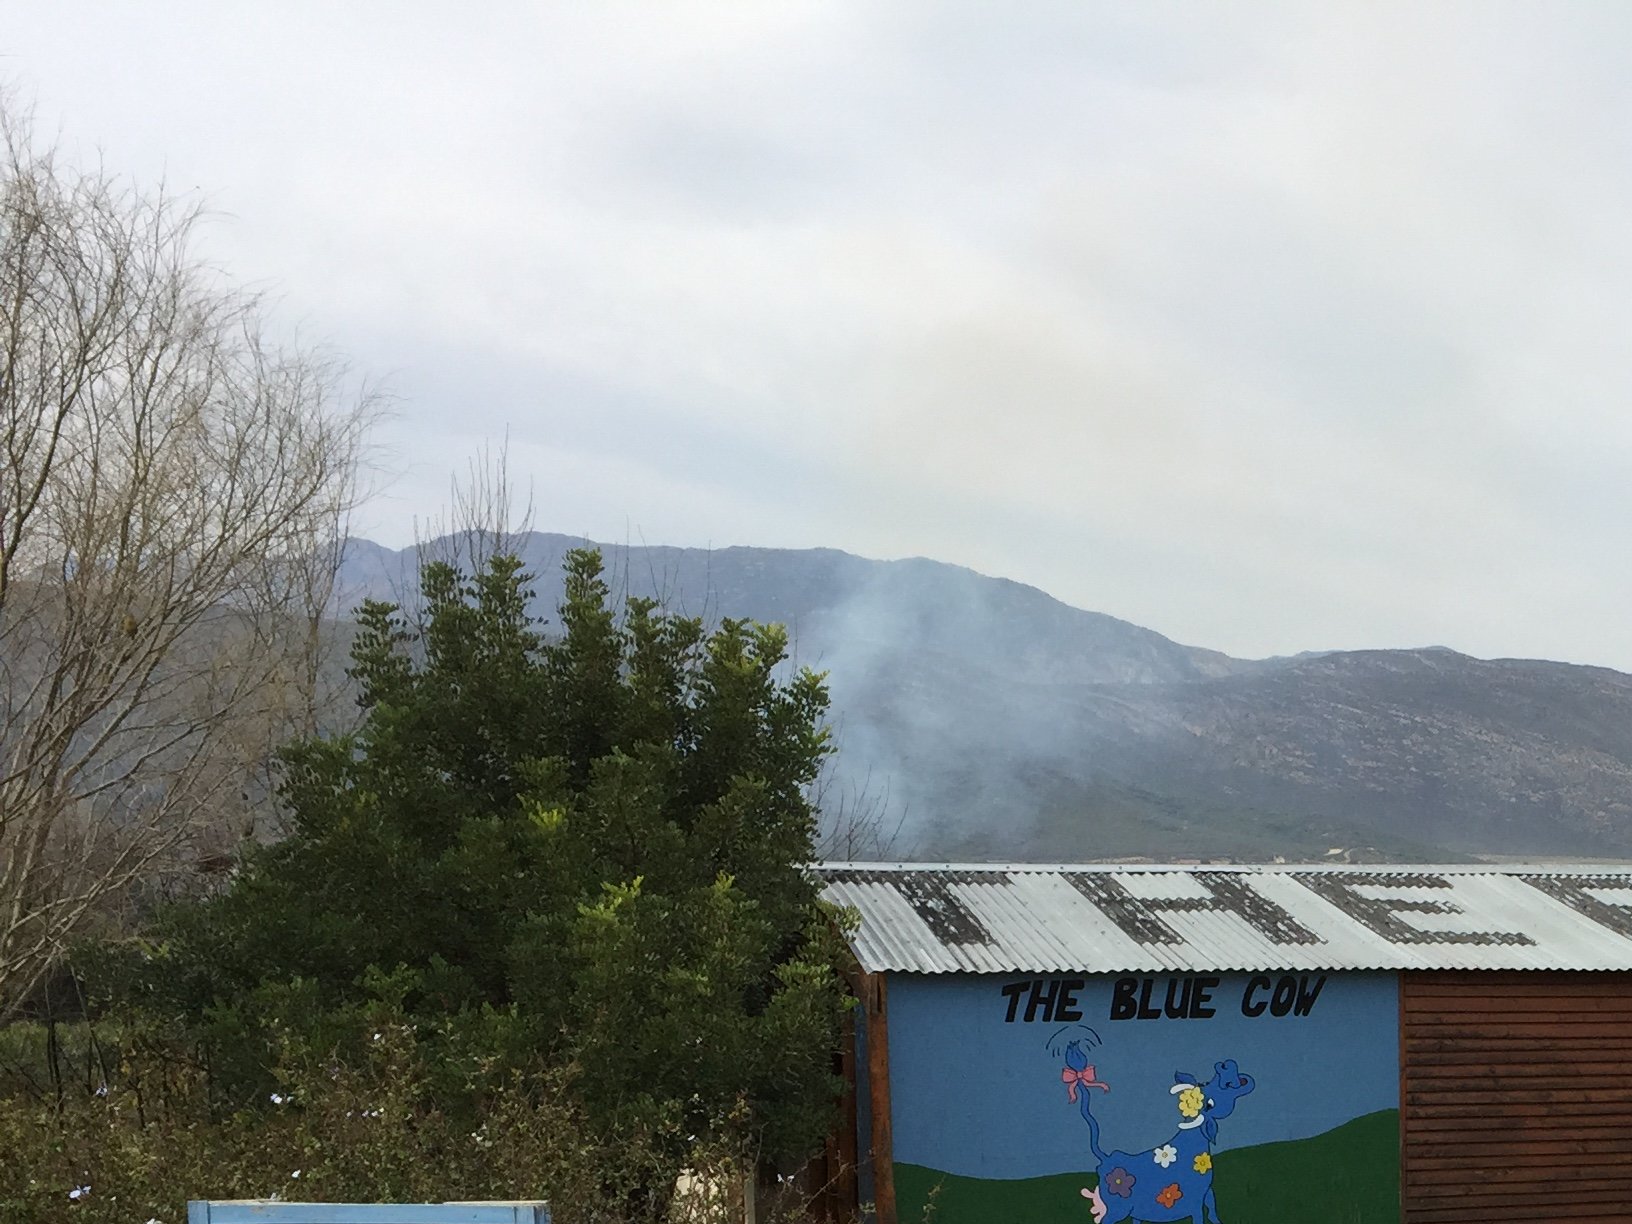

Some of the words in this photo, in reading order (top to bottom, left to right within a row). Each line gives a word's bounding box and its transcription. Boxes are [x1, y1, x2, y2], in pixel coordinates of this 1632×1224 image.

[816, 870, 1538, 947] THE
[1001, 978, 1085, 1023] THE
[1109, 976, 1220, 1021] BLUE
[1240, 975, 1327, 1018] COW
